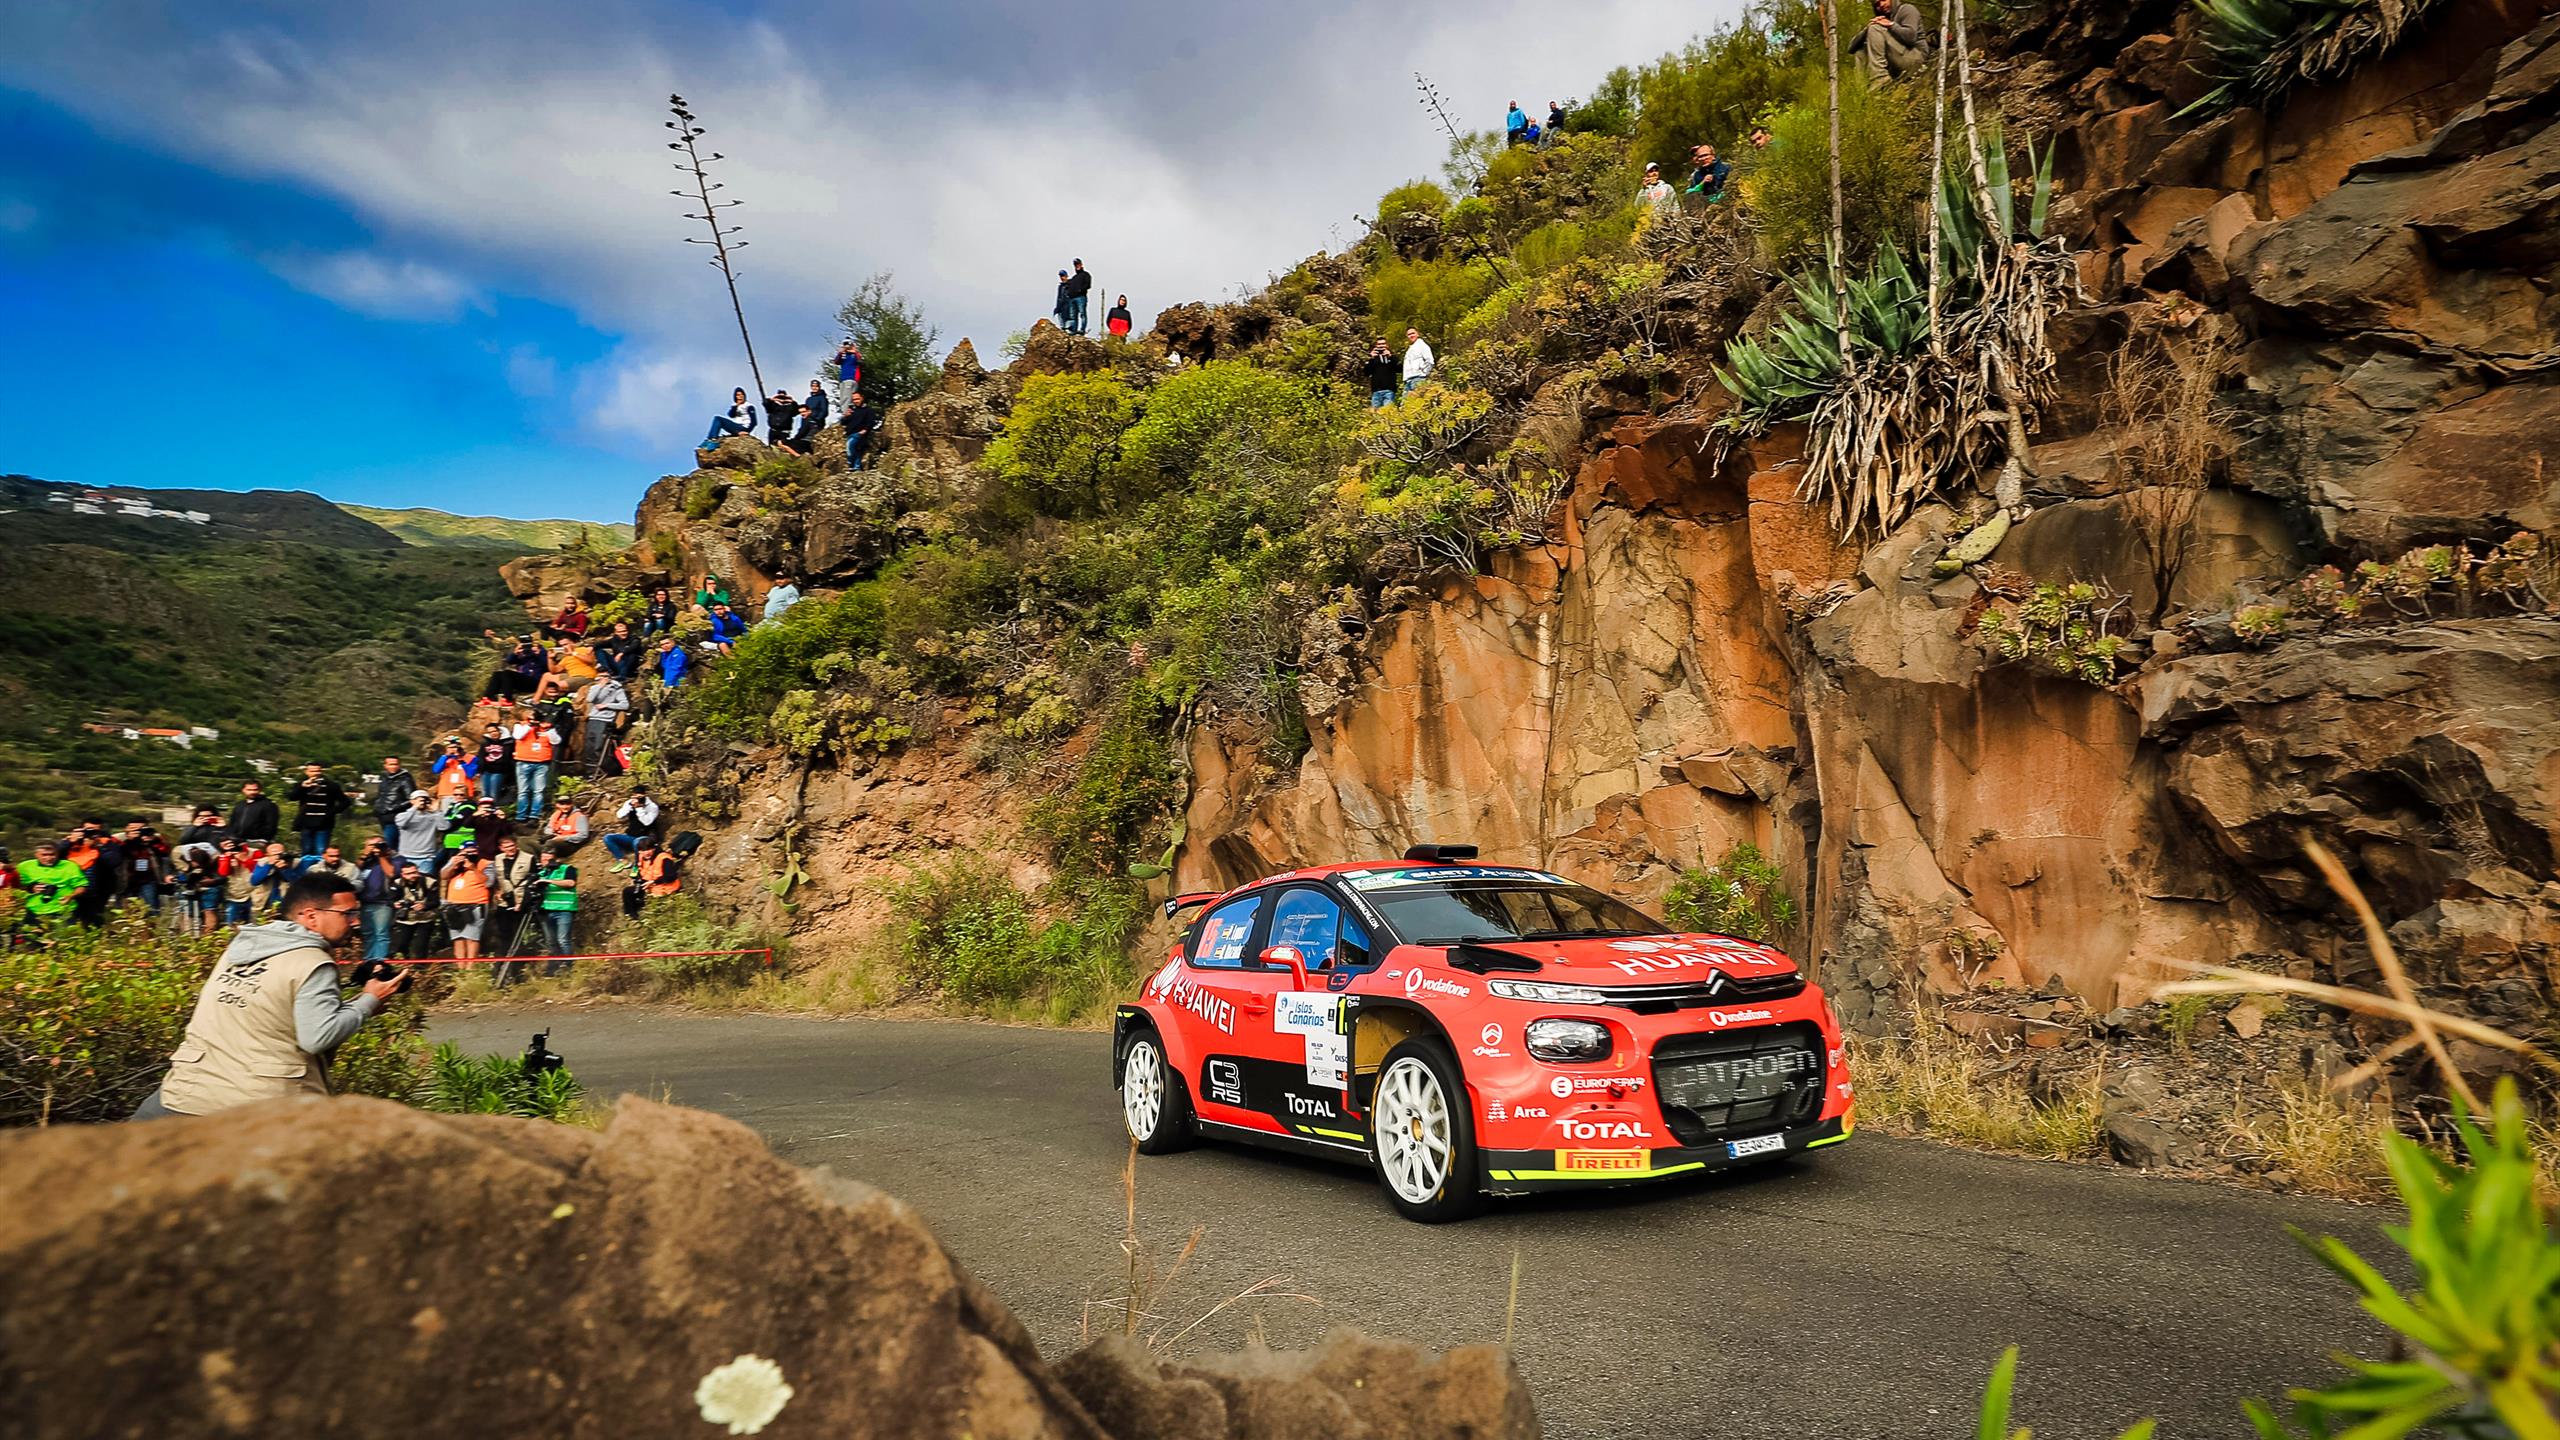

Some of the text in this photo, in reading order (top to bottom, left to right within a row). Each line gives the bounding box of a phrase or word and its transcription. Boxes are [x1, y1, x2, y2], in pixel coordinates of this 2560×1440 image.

[1607, 951, 1779, 976] HUAWEI
[1330, 973, 1349, 986] C3
[1422, 978, 1471, 998] vodafone
[1172, 974, 1237, 1036] HUAWEI
[1294, 1001, 1313, 1014] Islas
[1288, 1011, 1325, 1027] Canarias
[1209, 1059, 1241, 1090] C3
[1284, 1092, 1337, 1118] TOTAL
[1555, 1119, 1653, 1140] TOTAL
[1566, 1151, 1643, 1169] PIRELLI
